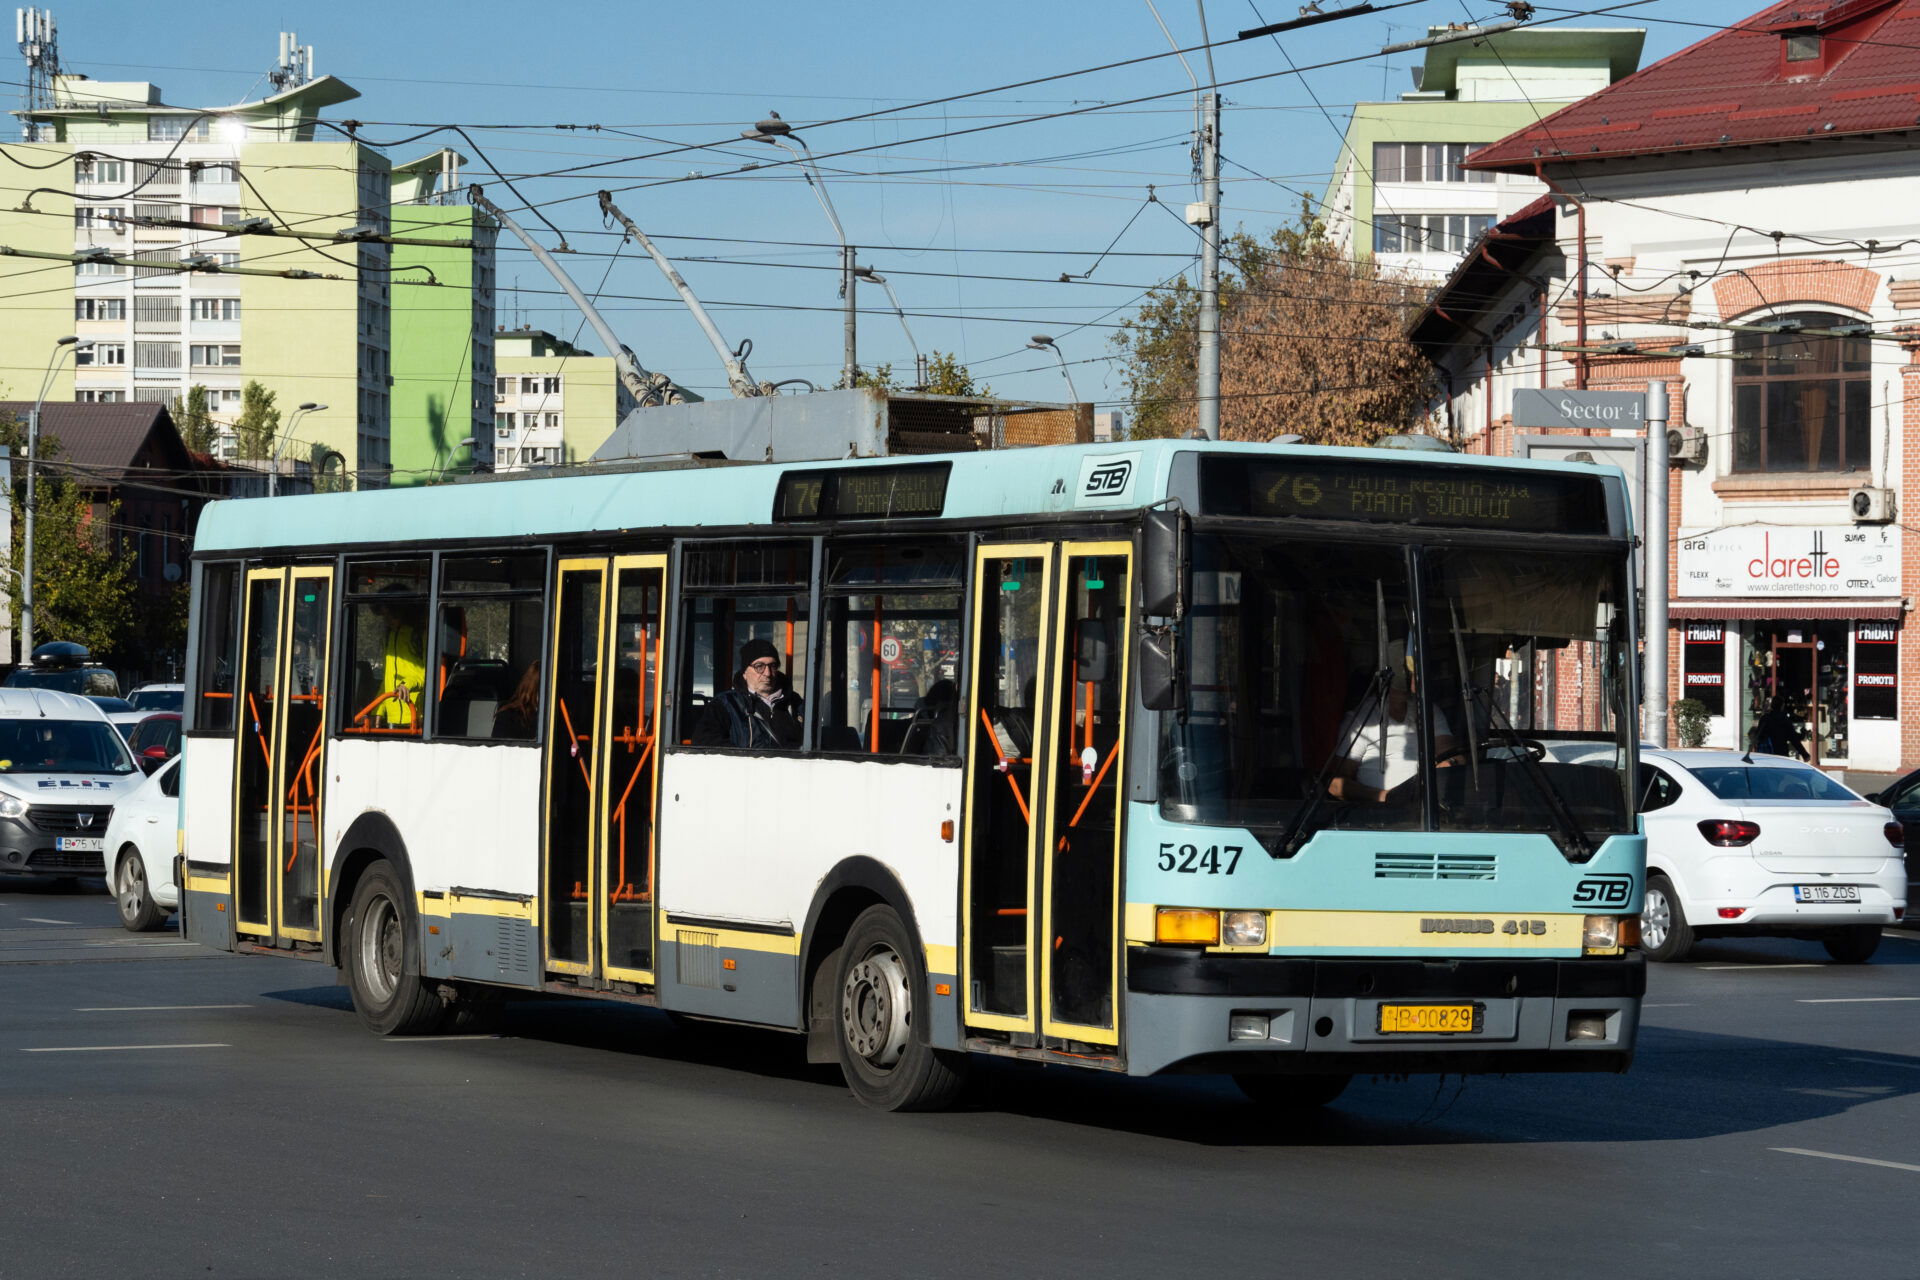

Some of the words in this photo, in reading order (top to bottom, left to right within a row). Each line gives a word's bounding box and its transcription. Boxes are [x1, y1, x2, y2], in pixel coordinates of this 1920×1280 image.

[1559, 399, 1623, 420] Sector
[1628, 401, 1640, 421] 4
[1086, 466, 1128, 491] STB
[1351, 490, 1413, 513] PIATA
[1426, 493, 1511, 519] SUDULUI
[1683, 538, 1706, 551] ara
[1747, 530, 1840, 579] clarette
[1689, 571, 1709, 579] FLEXX
[1747, 582, 1839, 594] www.claretteshop.ro
[1687, 624, 1722, 641] FRIDAY
[1858, 623, 1896, 641] FRIDAY
[884, 644, 896, 657] 60
[65, 838, 72, 849] B
[75, 838, 88, 849] 75
[1157, 842, 1244, 876] 5247
[1573, 879, 1630, 903] STB
[1802, 887, 1812, 899] B
[1814, 886, 1829, 899] 116
[1832, 886, 1856, 899] ZDS
[1420, 918, 1495, 934] IKARUS
[1502, 919, 1547, 935] 415
[1398, 1008, 1411, 1029] B
[1417, 1007, 1471, 1028] 00829
